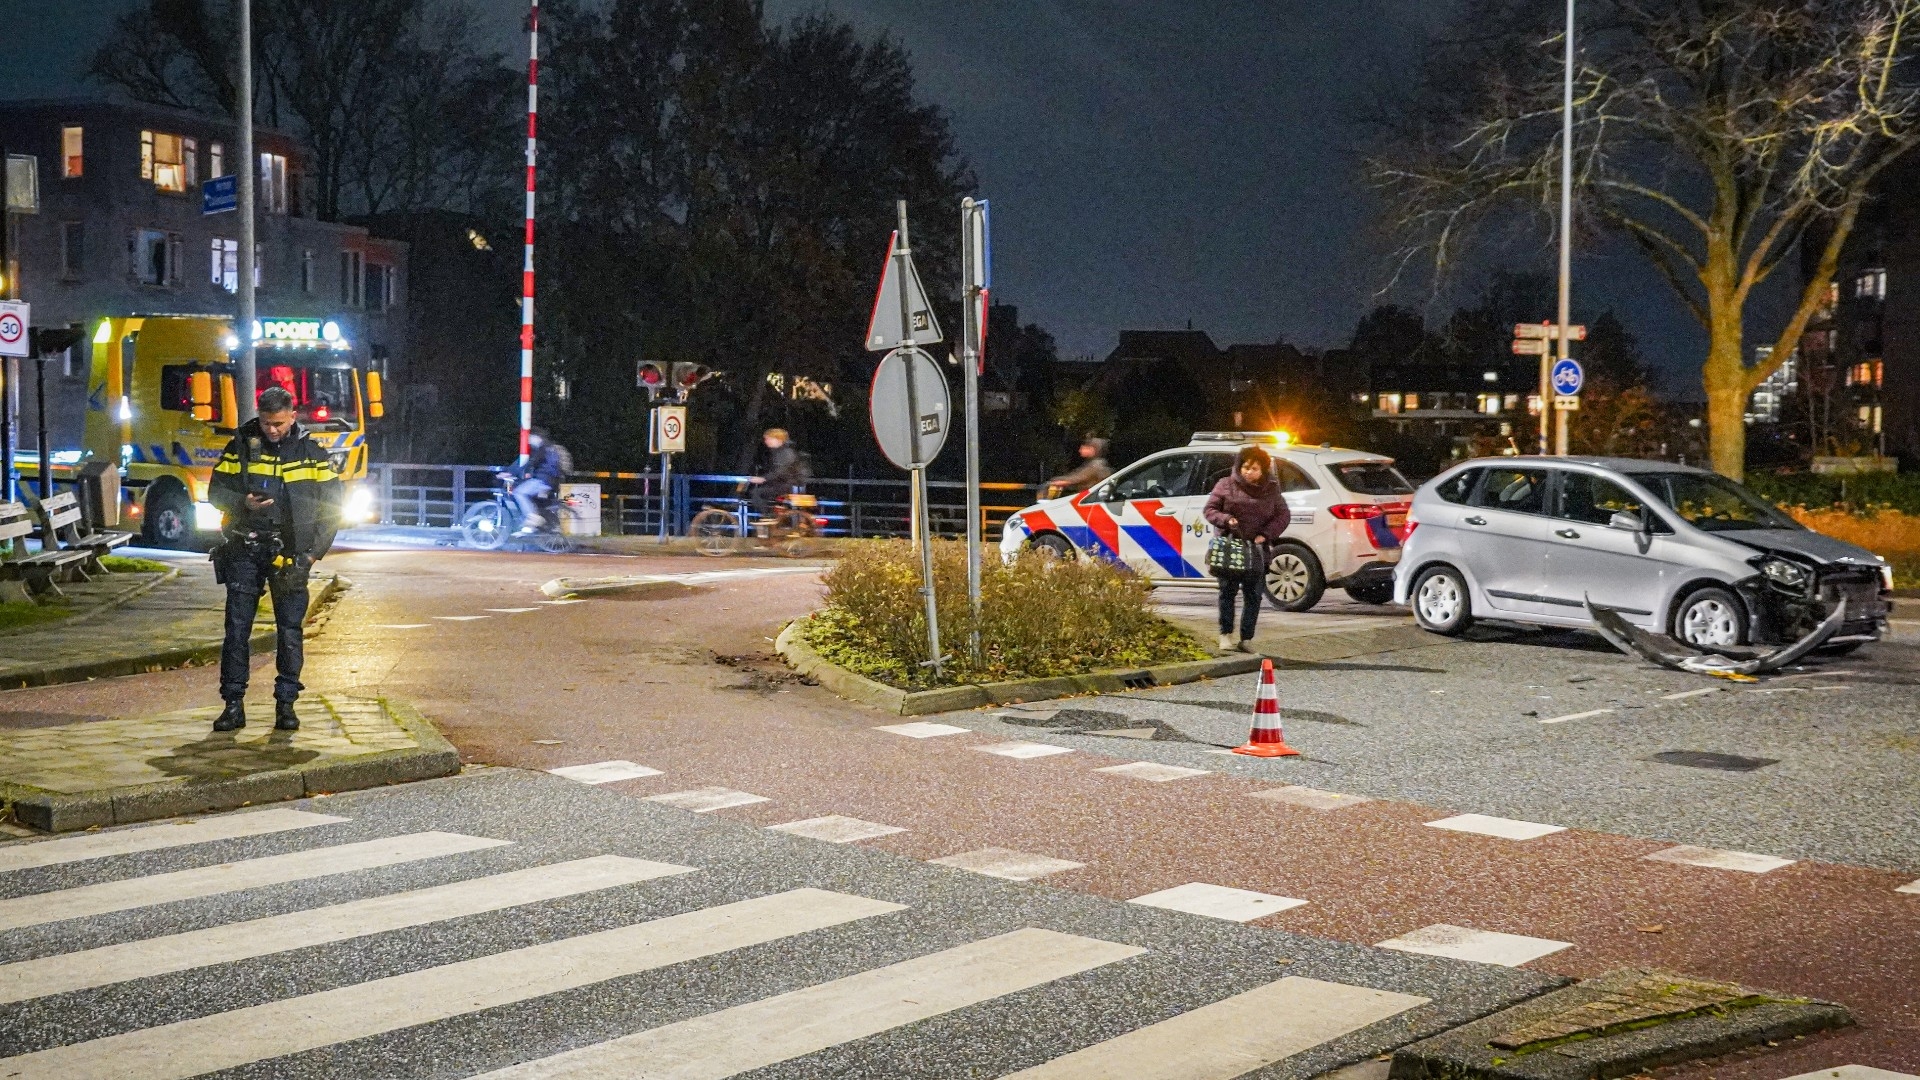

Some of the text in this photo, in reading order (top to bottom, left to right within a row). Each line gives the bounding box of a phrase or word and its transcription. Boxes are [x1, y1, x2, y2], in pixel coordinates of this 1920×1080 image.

[2, 322, 18, 334] 30
[264, 321, 320, 339] POORT
[668, 423, 677, 432] 30
[921, 419, 937, 431] EGA
